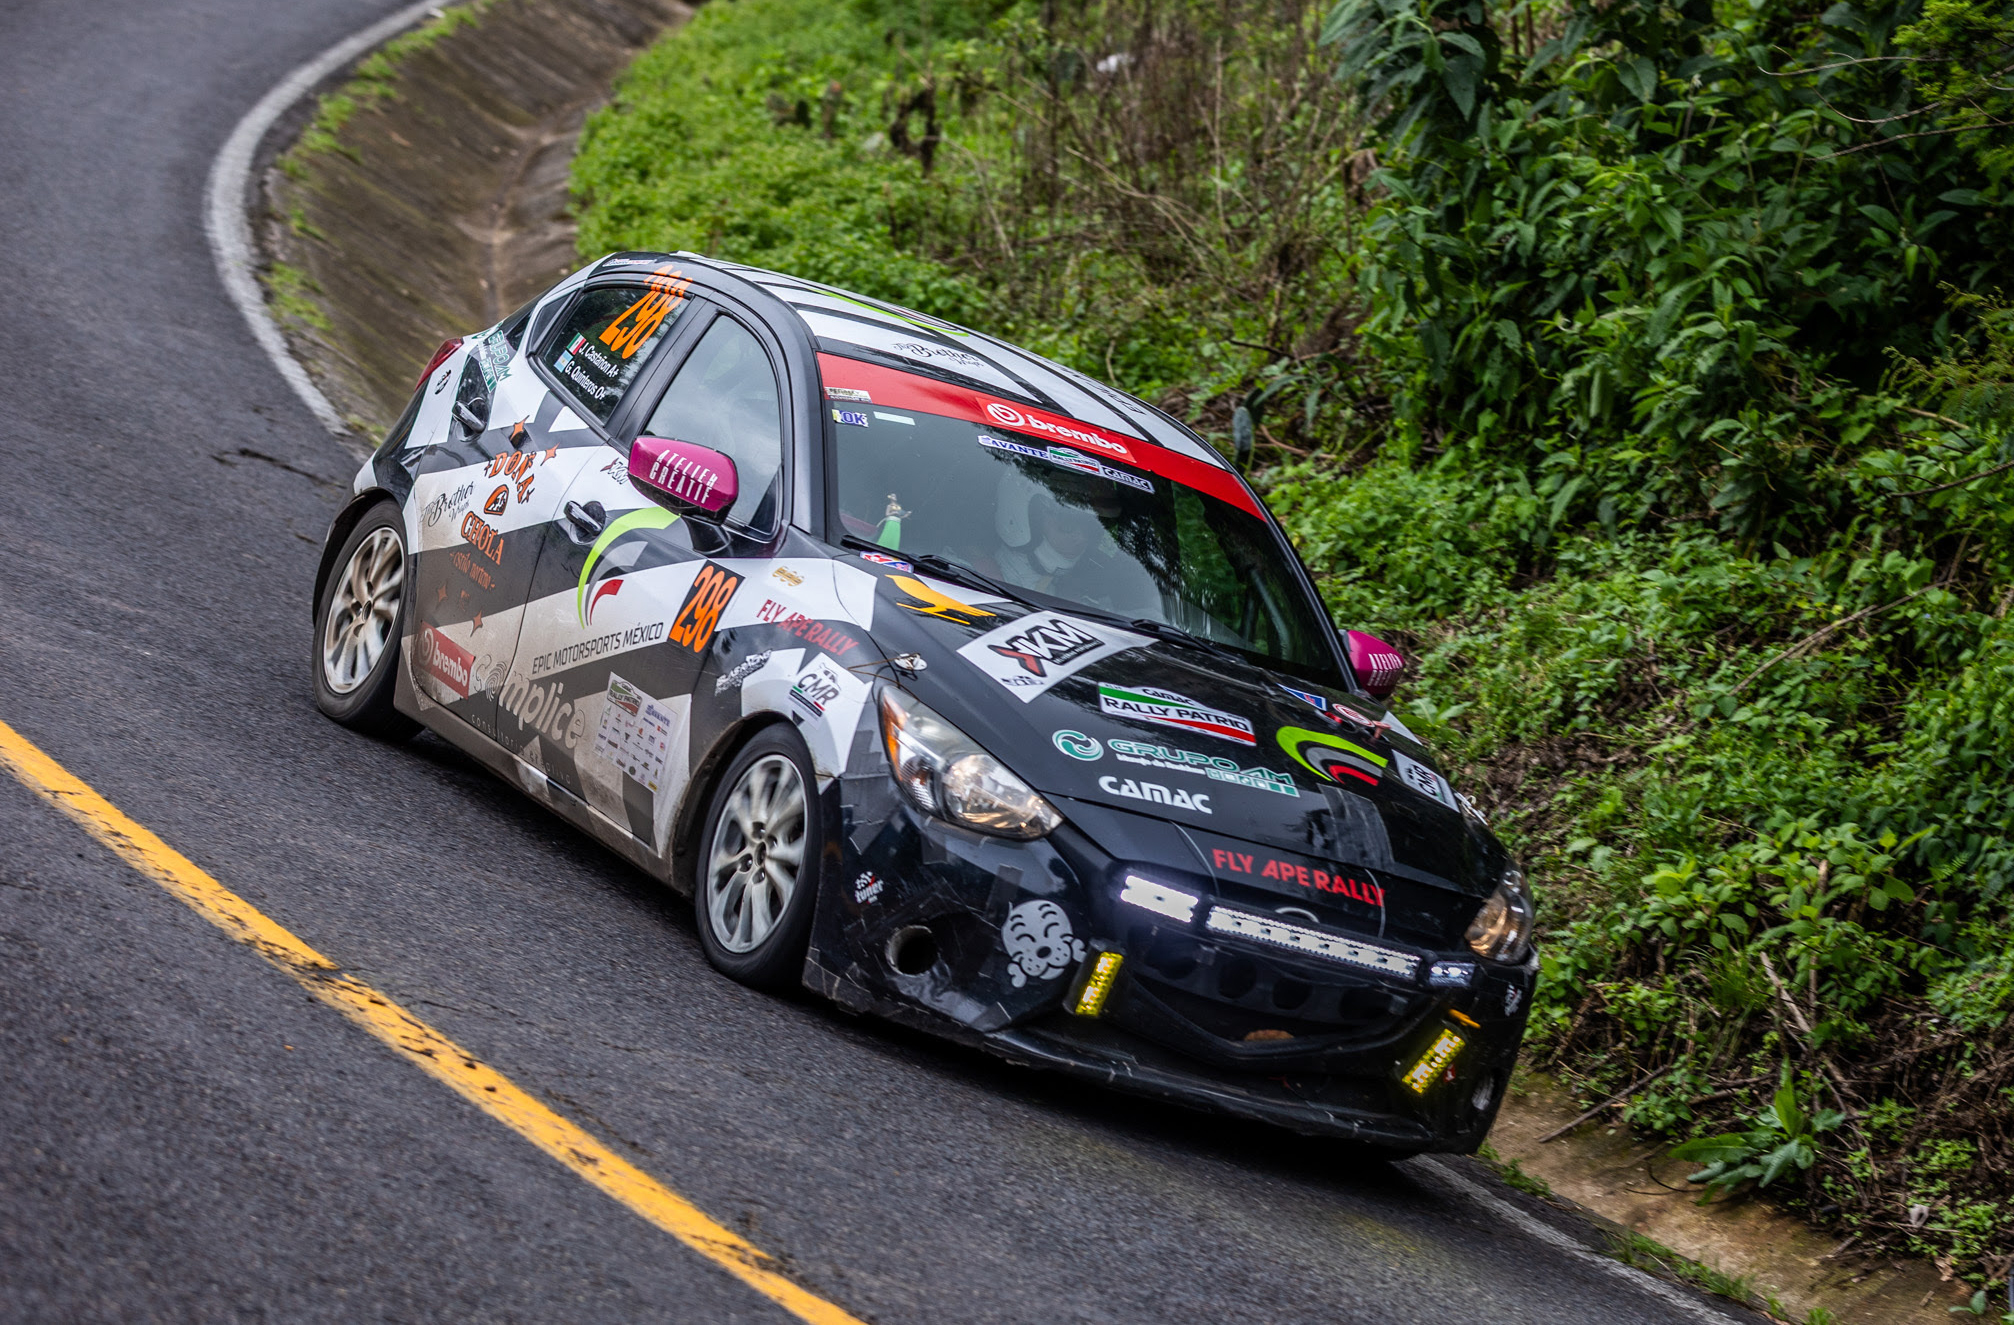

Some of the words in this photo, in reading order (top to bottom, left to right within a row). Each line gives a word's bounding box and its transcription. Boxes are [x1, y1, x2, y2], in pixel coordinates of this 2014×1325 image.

[599, 263, 693, 359] 298
[842, 412, 866, 425] OK
[1025, 413, 1128, 454] brembo
[991, 440, 1049, 459] AVANTE
[461, 511, 505, 566] CHOLA
[669, 565, 738, 653] 298
[756, 598, 787, 625] FLY
[777, 612, 815, 637] APE
[803, 622, 860, 656] RALLY
[432, 641, 468, 687] brembo
[532, 657, 551, 675] EPIC
[553, 632, 621, 667] MOTORSPORTS
[622, 622, 664, 646] MÉXICO
[797, 673, 840, 706] CMR
[1103, 697, 1169, 716] RALLY
[1107, 738, 1240, 773] GRUPO
[1212, 848, 1254, 874] FLY
[1261, 859, 1311, 887] APE
[1312, 869, 1387, 907] RALLY
